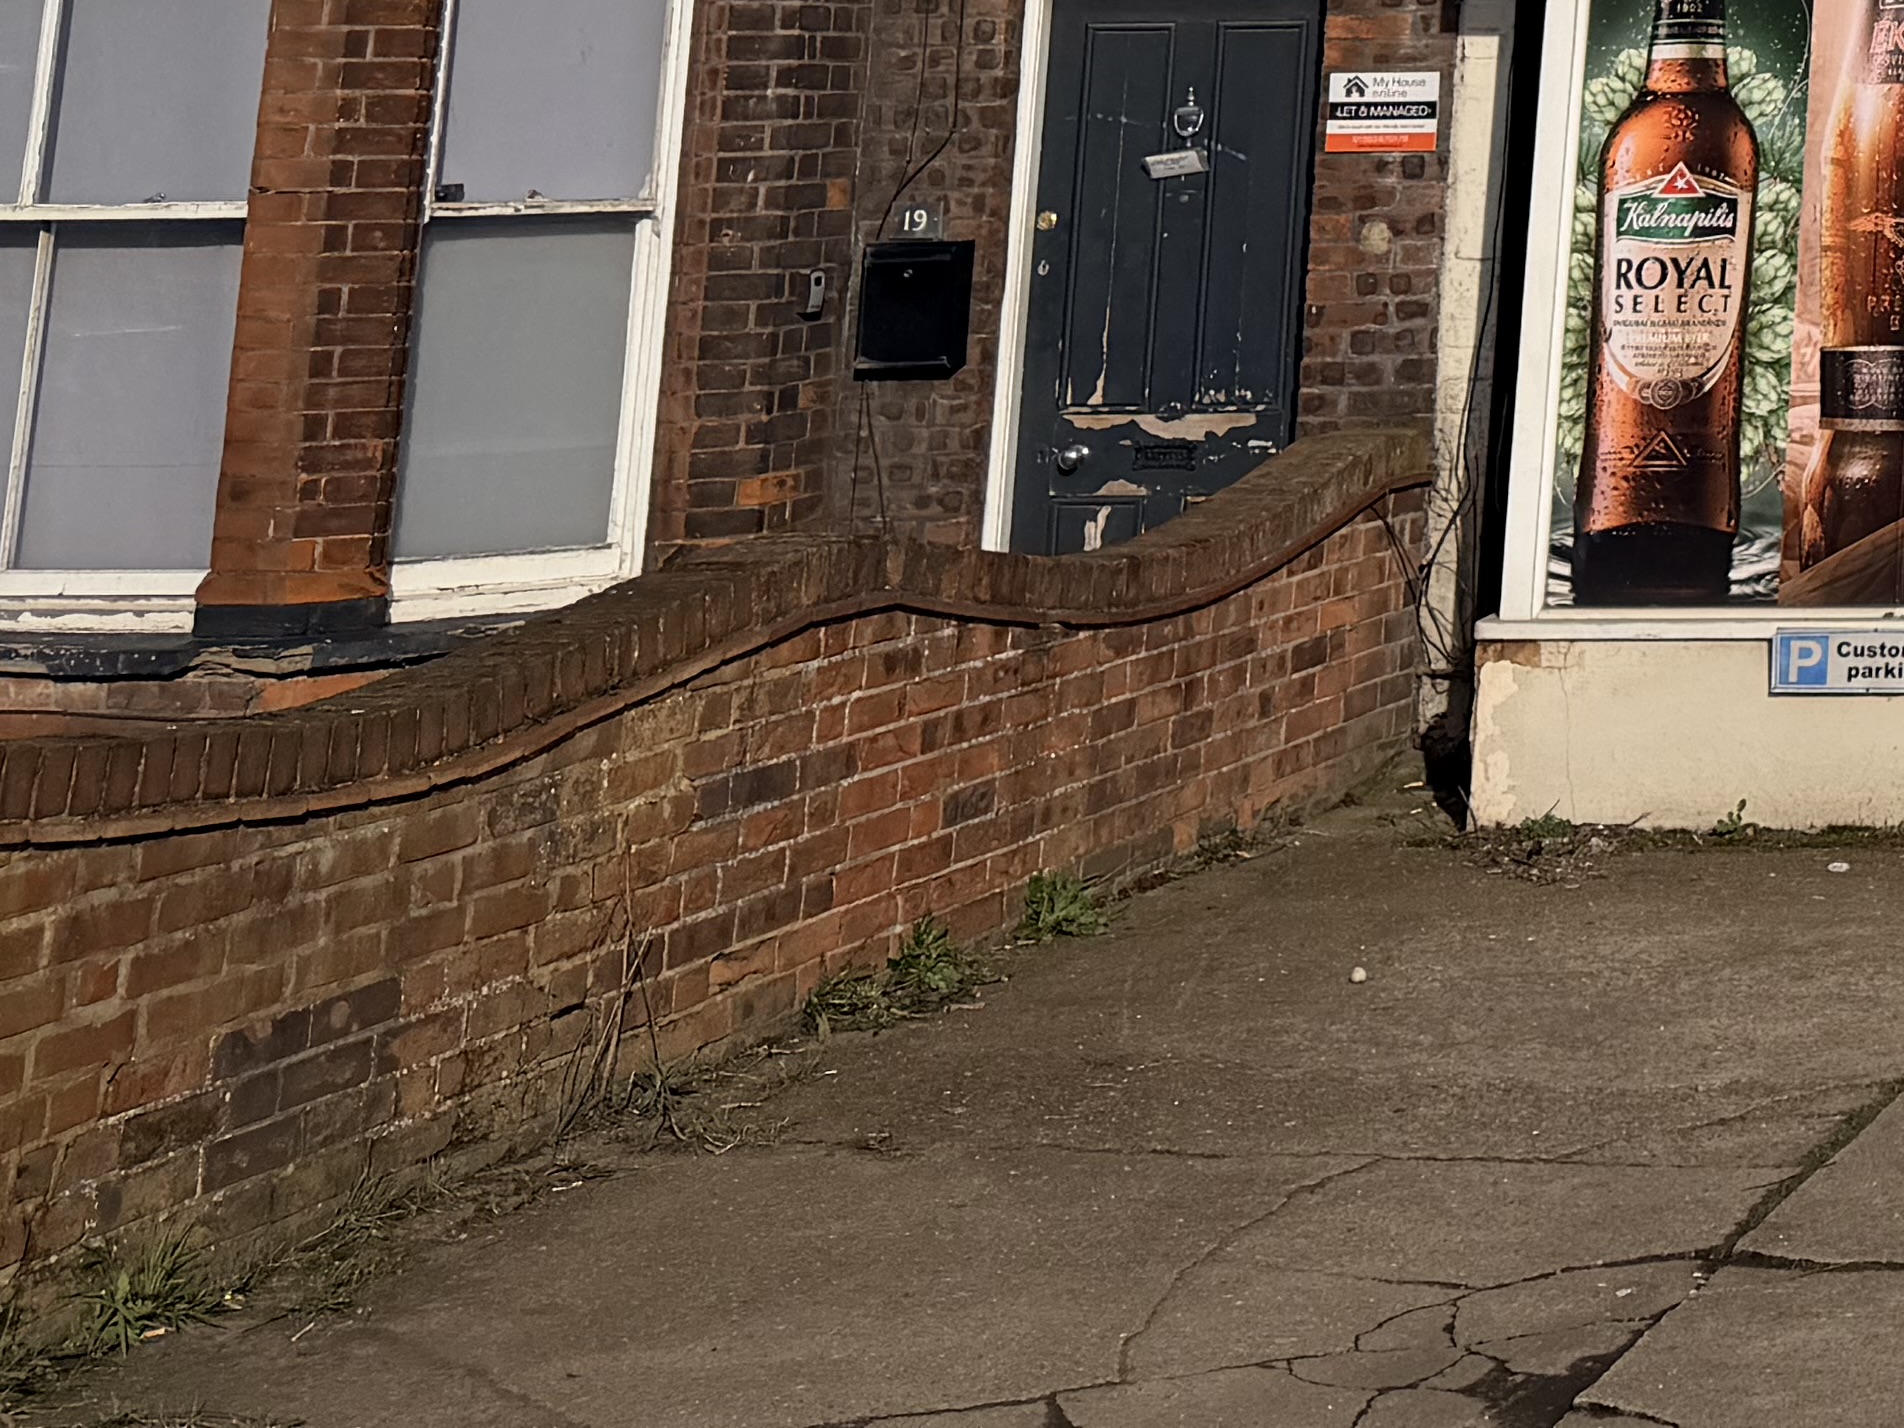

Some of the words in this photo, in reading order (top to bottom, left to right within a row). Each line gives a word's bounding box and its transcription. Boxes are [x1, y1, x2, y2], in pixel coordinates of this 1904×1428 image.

[1392, 76, 1426, 87] House
[1337, 105, 1357, 117] LET
[1369, 105, 1428, 117] MANAGED
[903, 209, 928, 232] 19
[1619, 198, 1735, 237] Kalnapilis
[1615, 256, 1732, 291] ROYAL
[1614, 293, 1732, 314] SELECT
